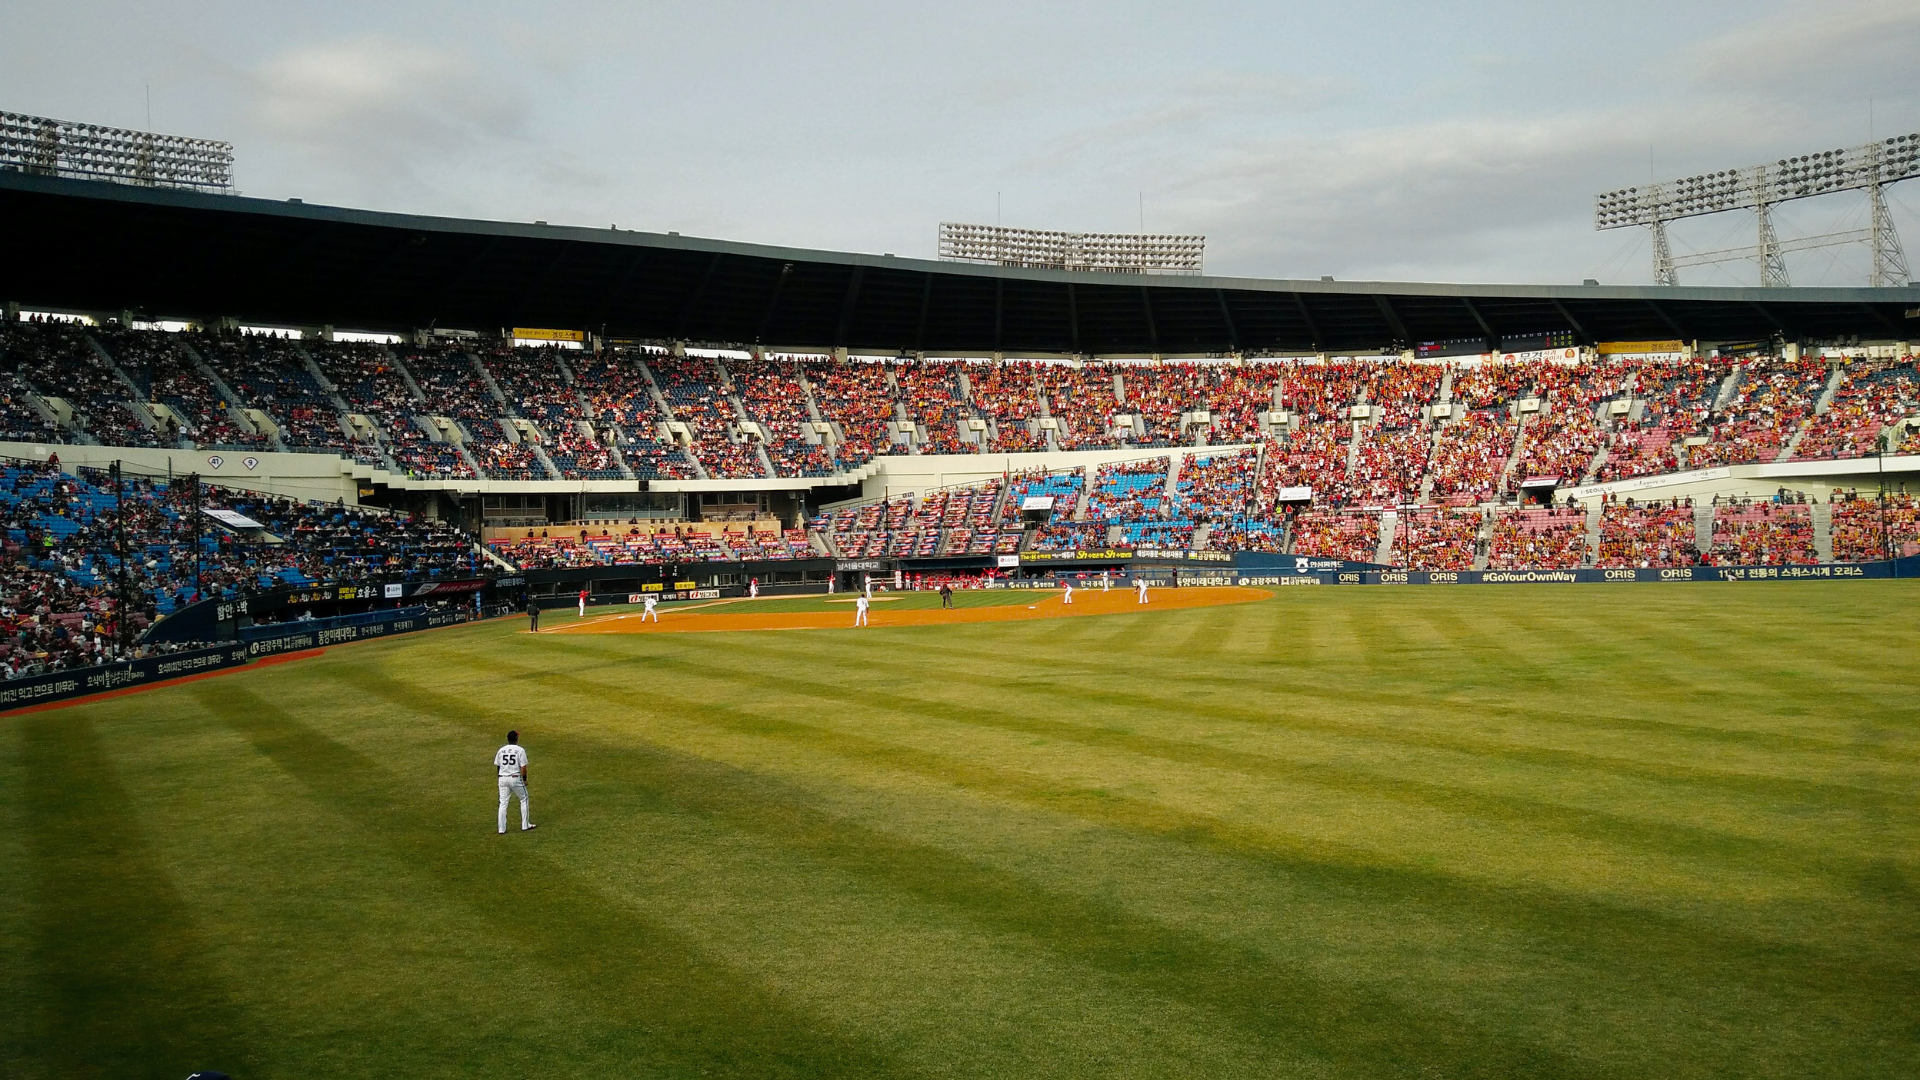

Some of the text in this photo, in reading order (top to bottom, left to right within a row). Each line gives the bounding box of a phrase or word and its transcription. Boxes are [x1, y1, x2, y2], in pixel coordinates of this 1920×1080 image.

[1076, 550, 1088, 559] Sh
[1104, 550, 1116, 558] Sh
[837, 561, 879, 570] 남서울대학교
[1430, 573, 1458, 581] ORIS
[1482, 572, 1576, 582] #GoYourOwnWay
[1604, 570, 1636, 579] ORIS
[1661, 569, 1692, 578] ORIS
[1718, 566, 1864, 579] 11년 전통의 스위스시계 오리스
[1250, 577, 1278, 585] 금강주택
[1338, 573, 1360, 582] ORIS
[1380, 573, 1408, 582] ORIS
[357, 586, 377, 598] 호올스
[318, 627, 357, 645] 동양미래대학교
[260, 639, 282, 652] 금강주택
[0, 690, 17, 703] 치킨
[18, 687, 33, 699] 먹고
[502, 755, 516, 765] 55
